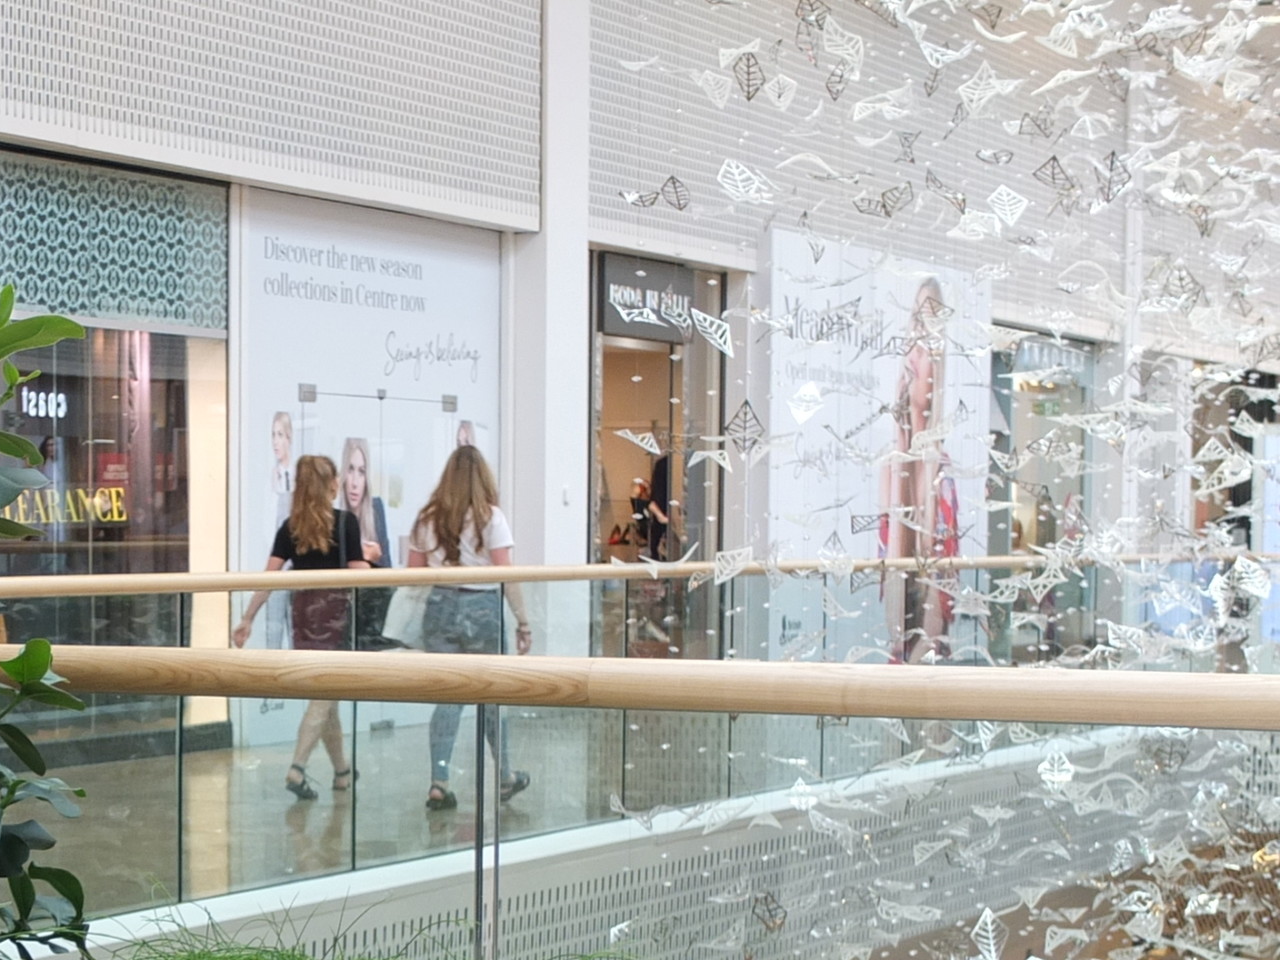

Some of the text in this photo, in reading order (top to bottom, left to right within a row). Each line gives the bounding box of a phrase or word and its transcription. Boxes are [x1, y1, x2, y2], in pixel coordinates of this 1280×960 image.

[264, 236, 422, 281] Discover the new season
[263, 272, 426, 313] collections in Centre now
[1, 487, 127, 524] LEARANCE
